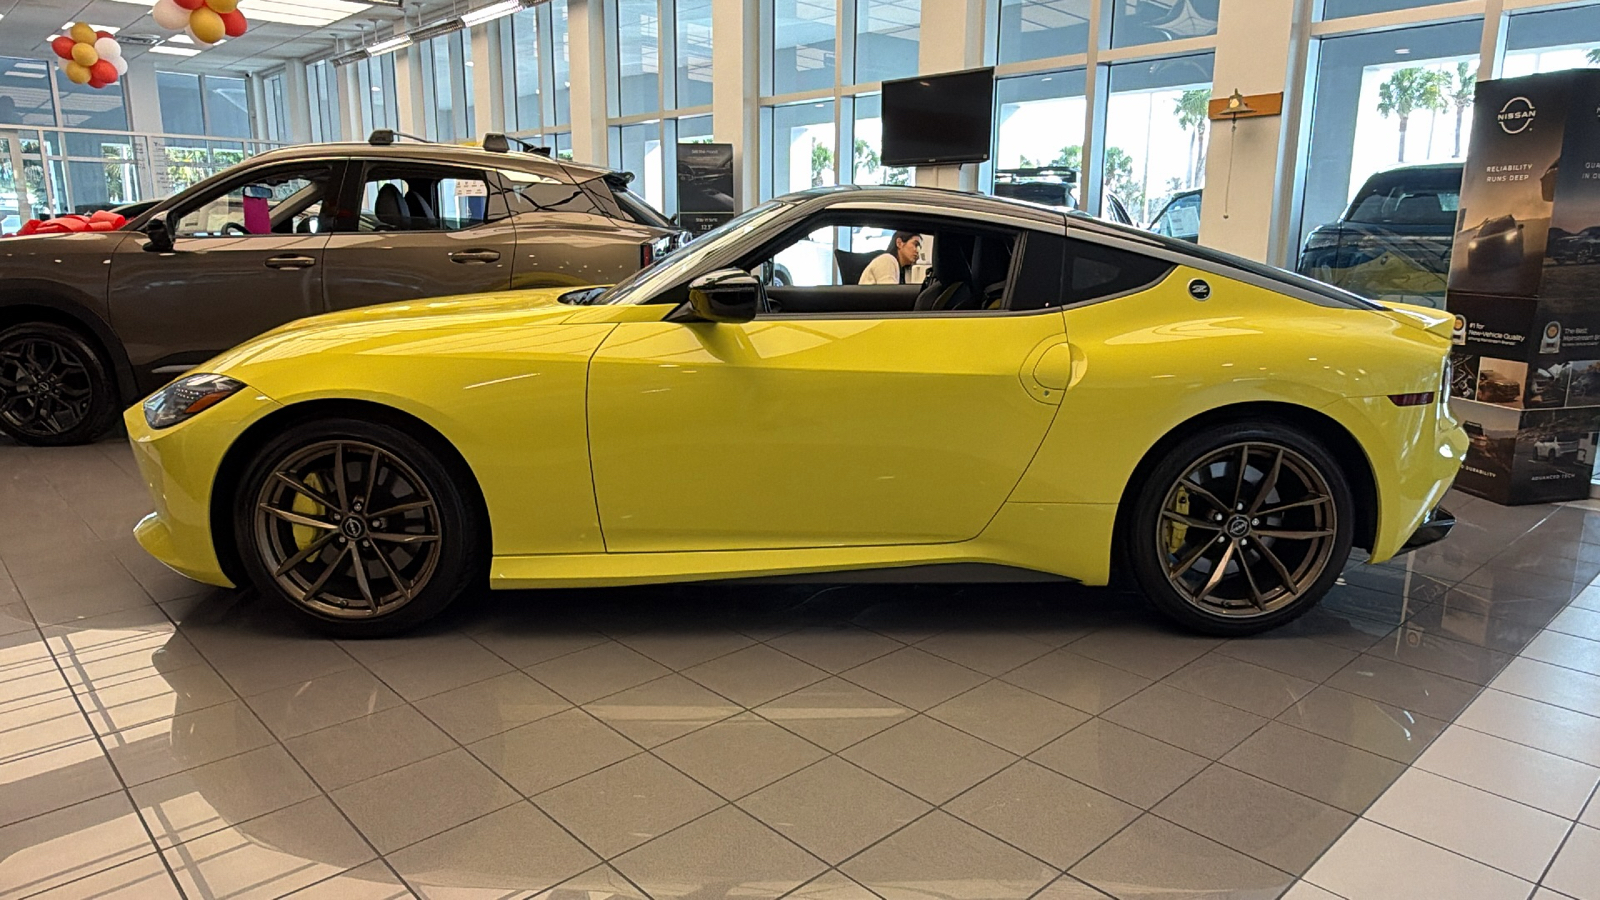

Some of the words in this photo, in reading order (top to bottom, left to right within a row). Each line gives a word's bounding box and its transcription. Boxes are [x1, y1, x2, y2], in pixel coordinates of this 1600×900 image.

[1497, 110, 1537, 120] NISSAN
[1486, 163, 1533, 172] RELIABILITY
[1503, 333, 1526, 343] Quality
[1465, 464, 1497, 478] DURABILITY
